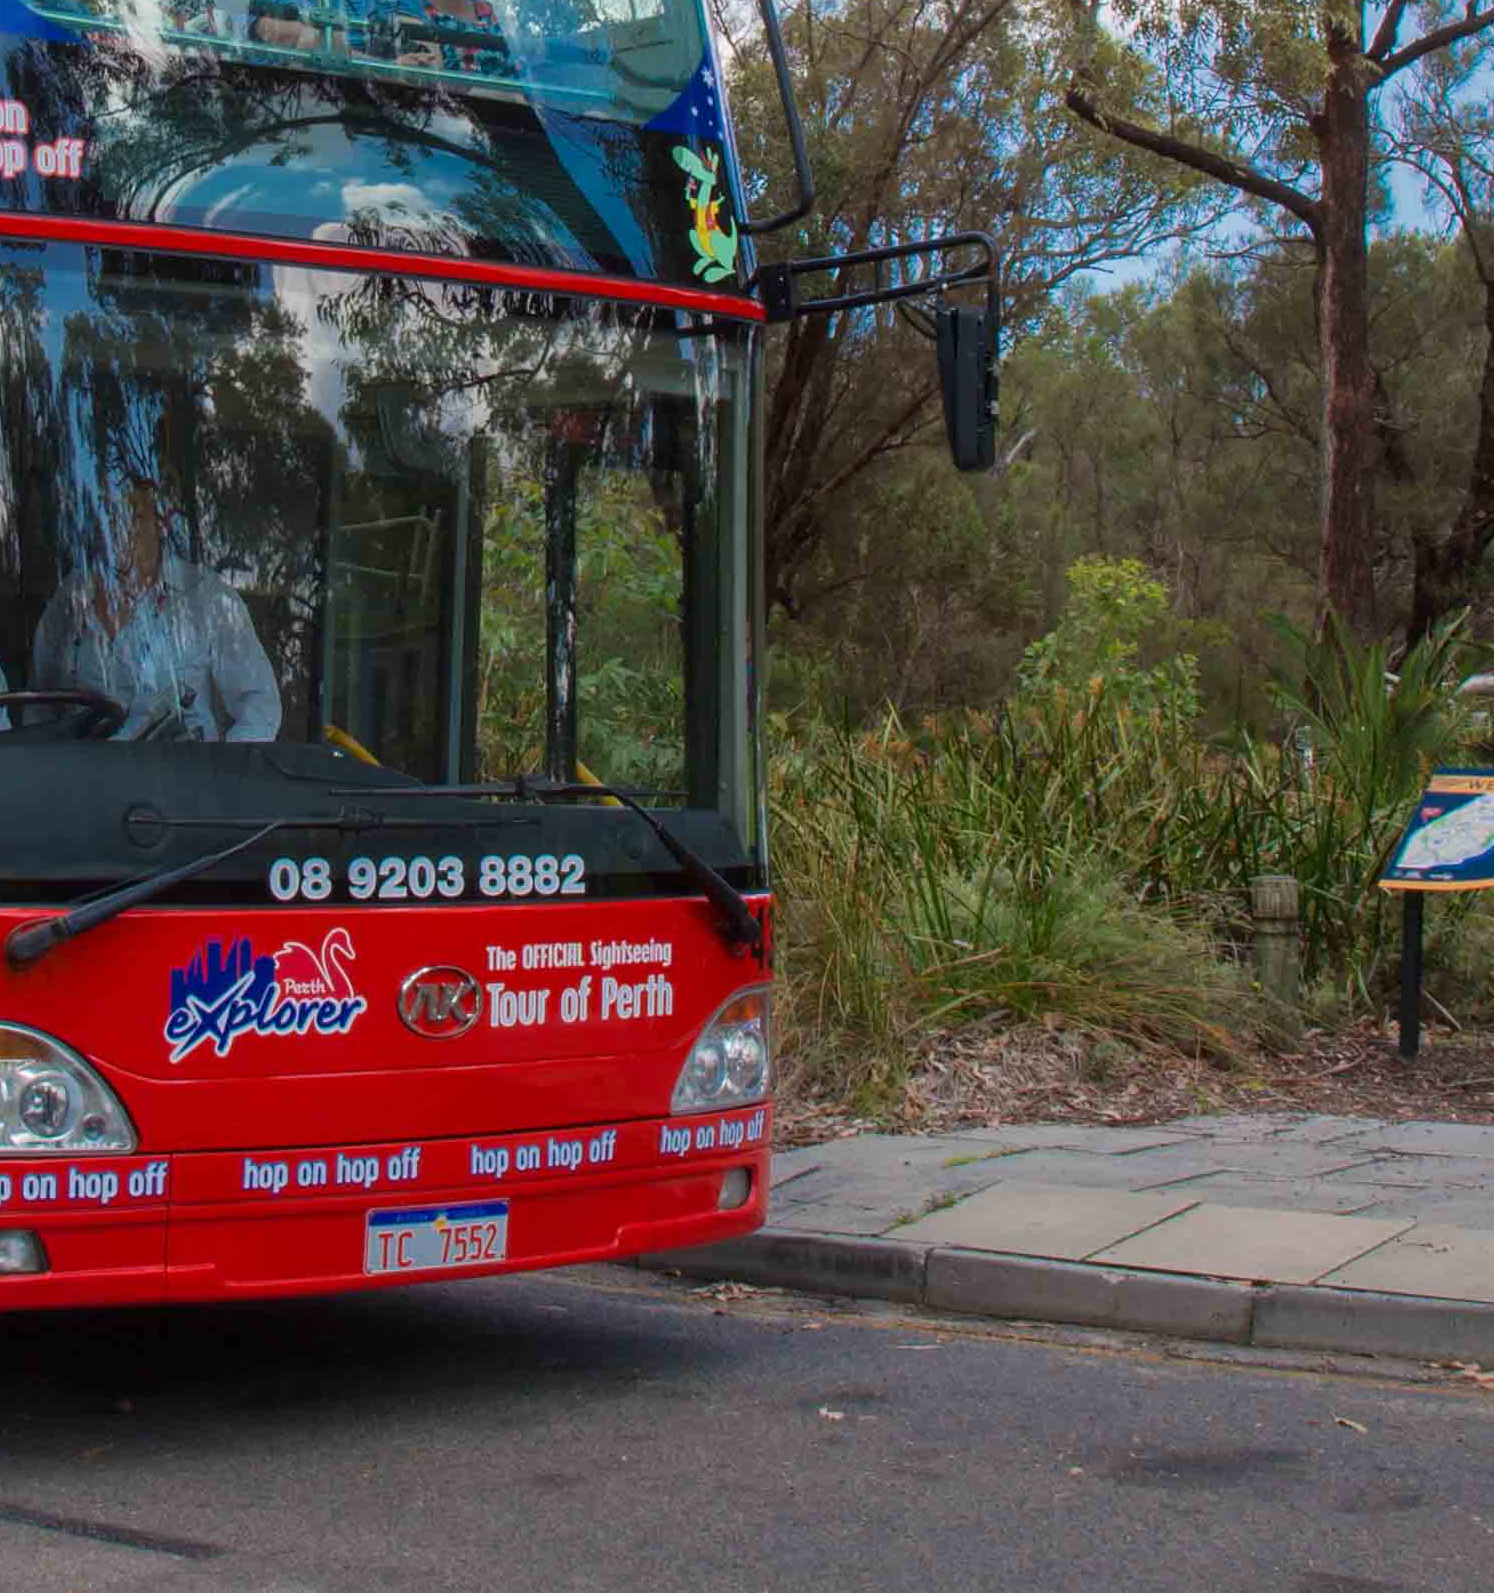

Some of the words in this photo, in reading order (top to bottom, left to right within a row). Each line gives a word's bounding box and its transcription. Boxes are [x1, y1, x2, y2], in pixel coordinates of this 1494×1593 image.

[33, 136, 85, 178] off
[269, 858, 332, 901] 08
[348, 856, 465, 899] 9203
[479, 854, 586, 896] 8882
[486, 945, 517, 971] The
[522, 942, 585, 970] OFFICIAL
[590, 937, 672, 970] Sightseeing
[283, 978, 326, 994] Perth
[486, 982, 550, 1028] Tour
[560, 975, 592, 1023] of
[601, 973, 673, 1020] Perth
[470, 1144, 510, 1179] hop
[515, 1146, 541, 1171] on
[547, 1137, 583, 1171] hop
[588, 1129, 617, 1164] off
[660, 1125, 691, 1157] hop
[696, 1126, 715, 1150] on
[719, 1117, 744, 1149] hop
[746, 1109, 765, 1142] off
[22, 1172, 57, 1201] on
[68, 1166, 118, 1203] hop
[128, 1161, 169, 1198] off
[242, 1158, 288, 1193] hop
[297, 1160, 327, 1187] on
[337, 1154, 379, 1188] hop
[387, 1147, 421, 1181] off
[377, 1231, 414, 1270] TC
[440, 1223, 498, 1263] 7552
